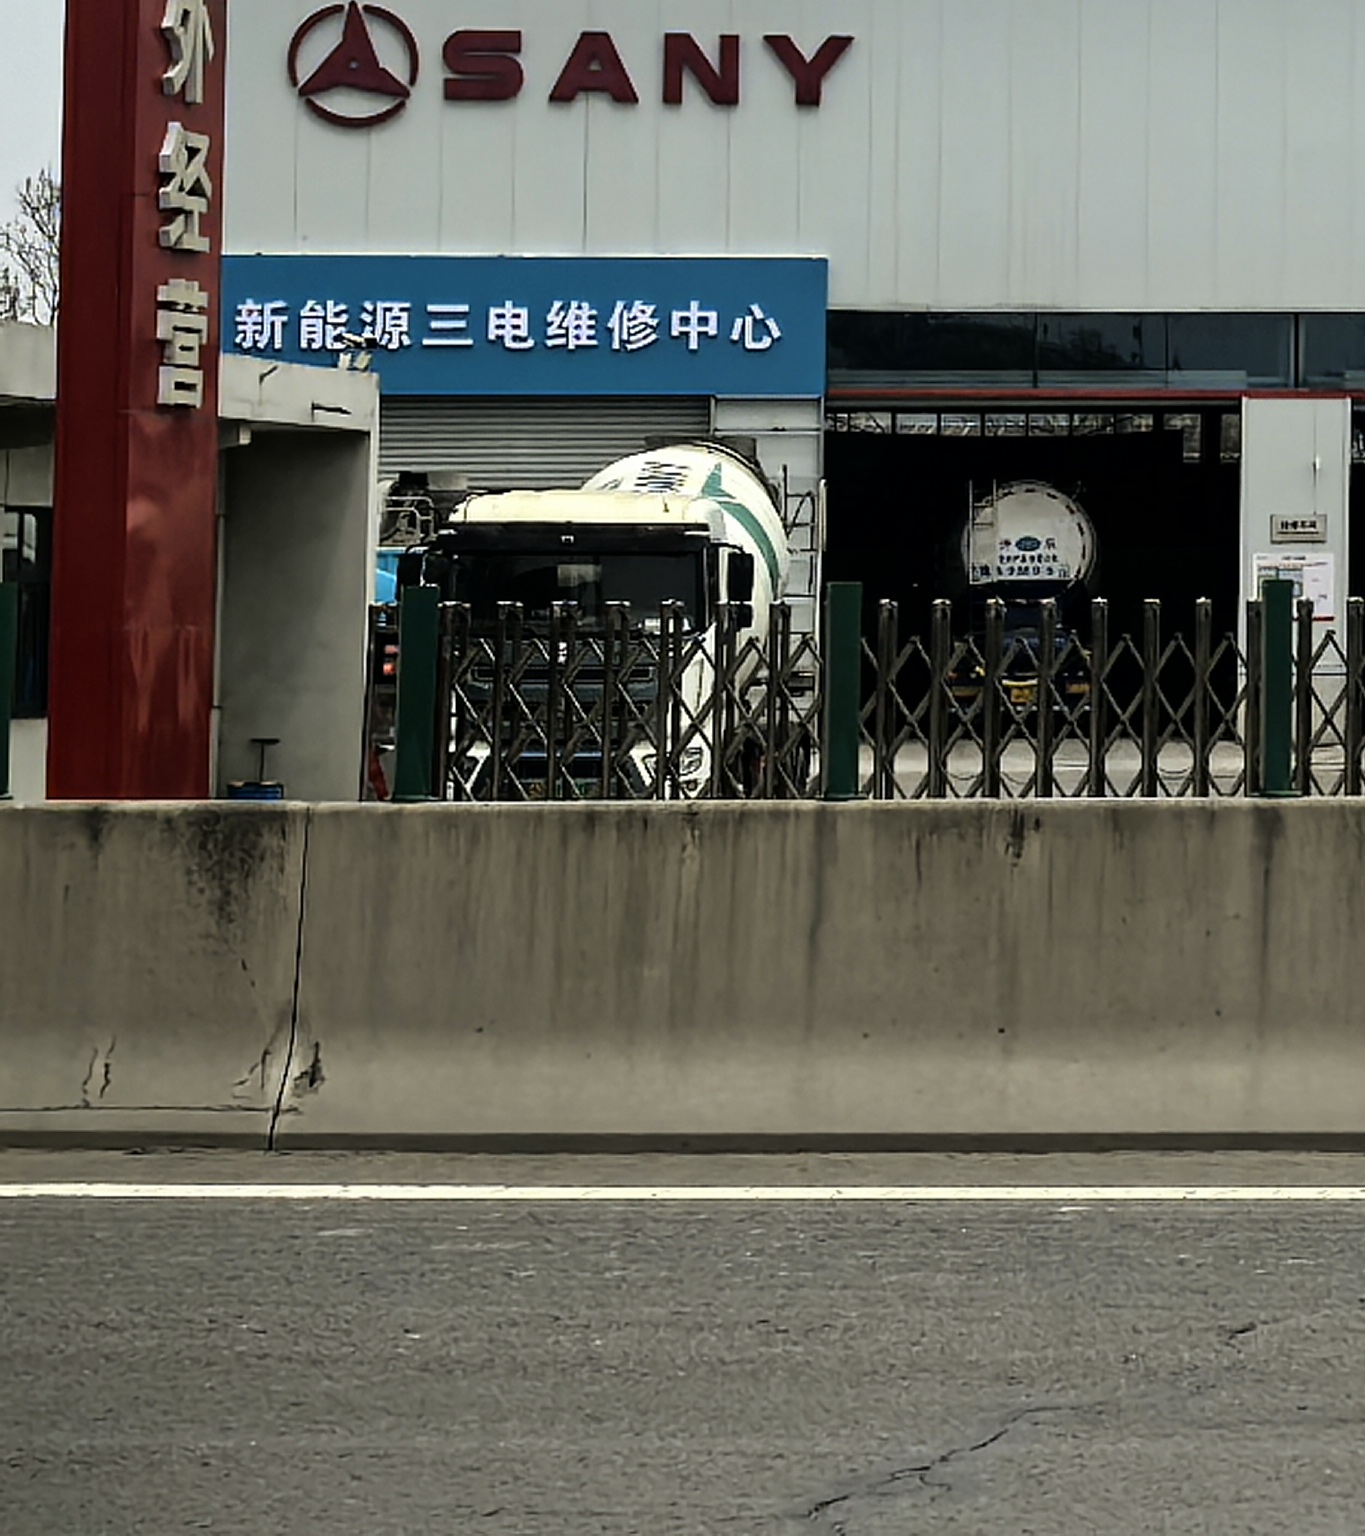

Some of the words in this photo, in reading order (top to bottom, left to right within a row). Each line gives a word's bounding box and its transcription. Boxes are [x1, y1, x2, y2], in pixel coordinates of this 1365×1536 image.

[441, 29, 854, 107] SANY
[234, 299, 782, 352] 新能源三电维修中心
